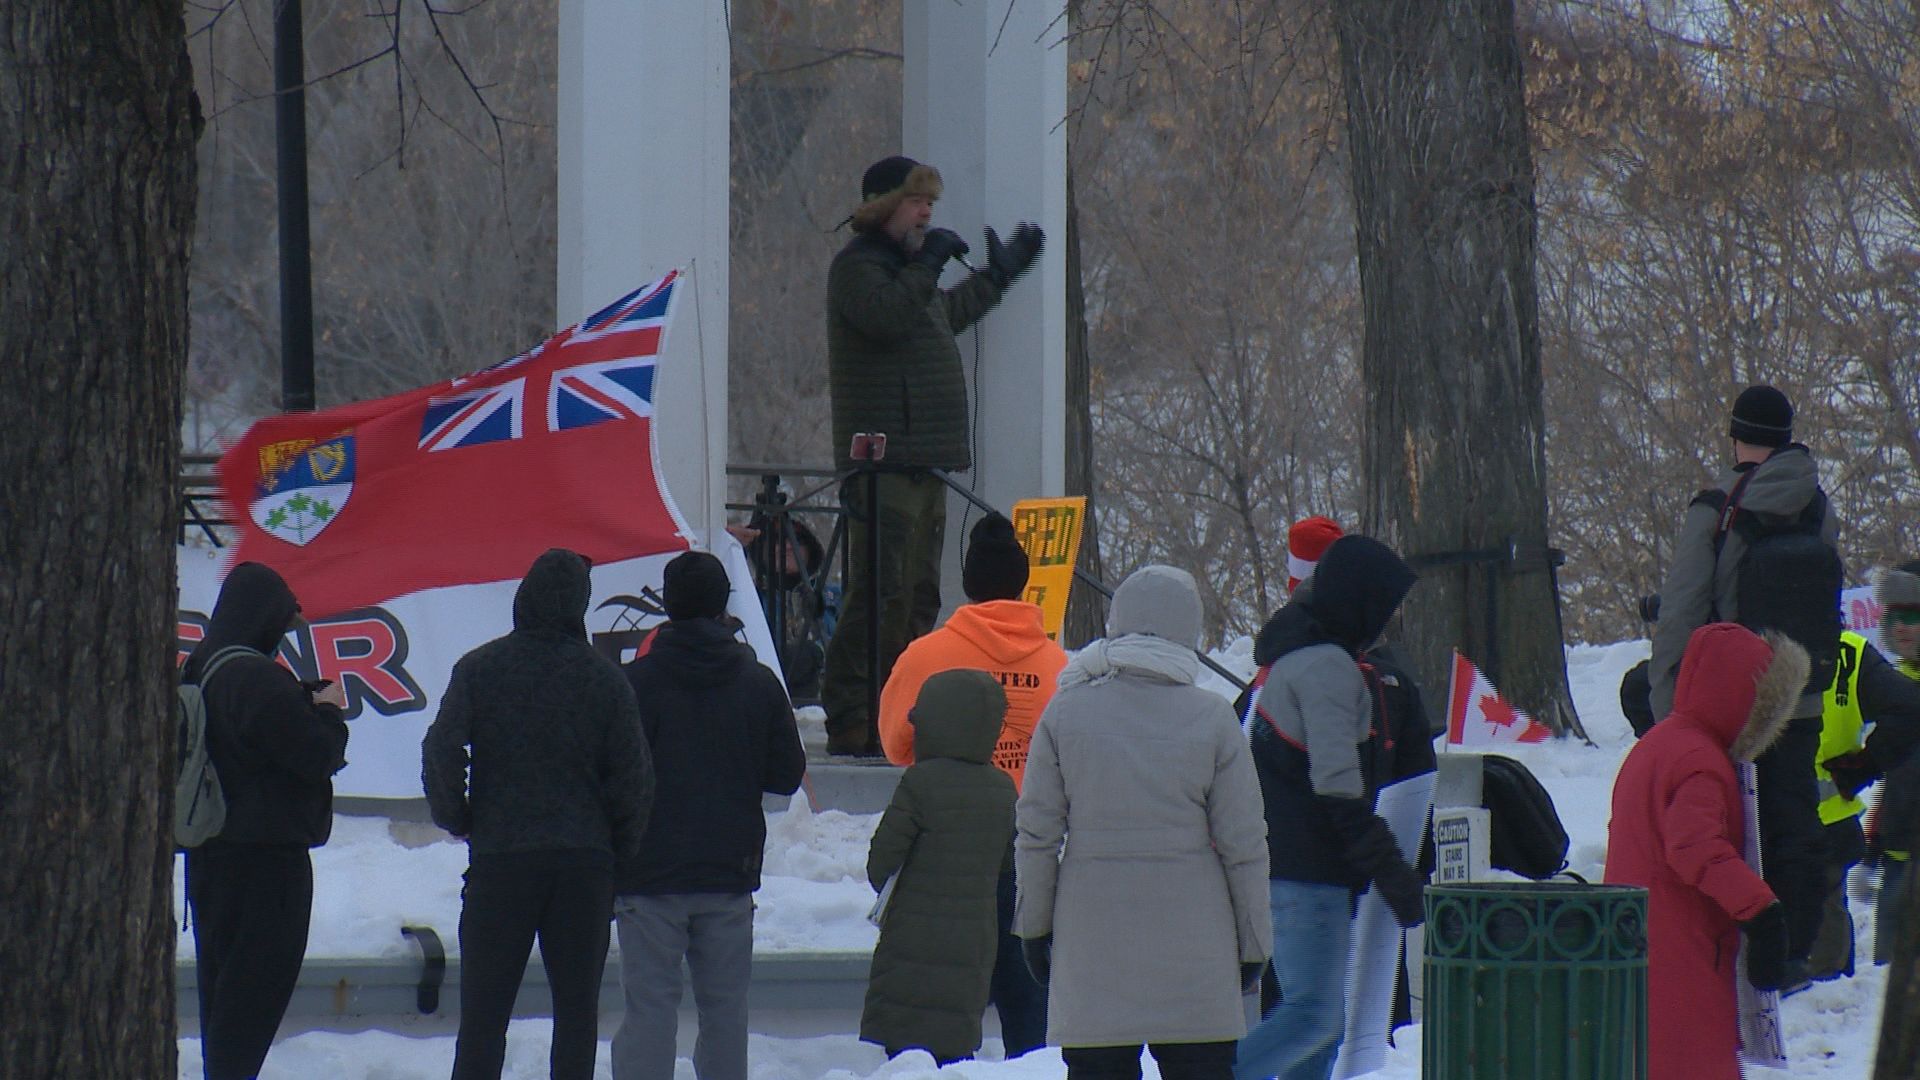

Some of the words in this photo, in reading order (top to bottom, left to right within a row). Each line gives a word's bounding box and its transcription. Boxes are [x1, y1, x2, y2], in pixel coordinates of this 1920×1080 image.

[1439, 823, 1468, 843] CAUTION
[1445, 847, 1463, 862] STAIRS
[1444, 867, 1455, 880] MAY
[1458, 865, 1465, 879] BE
